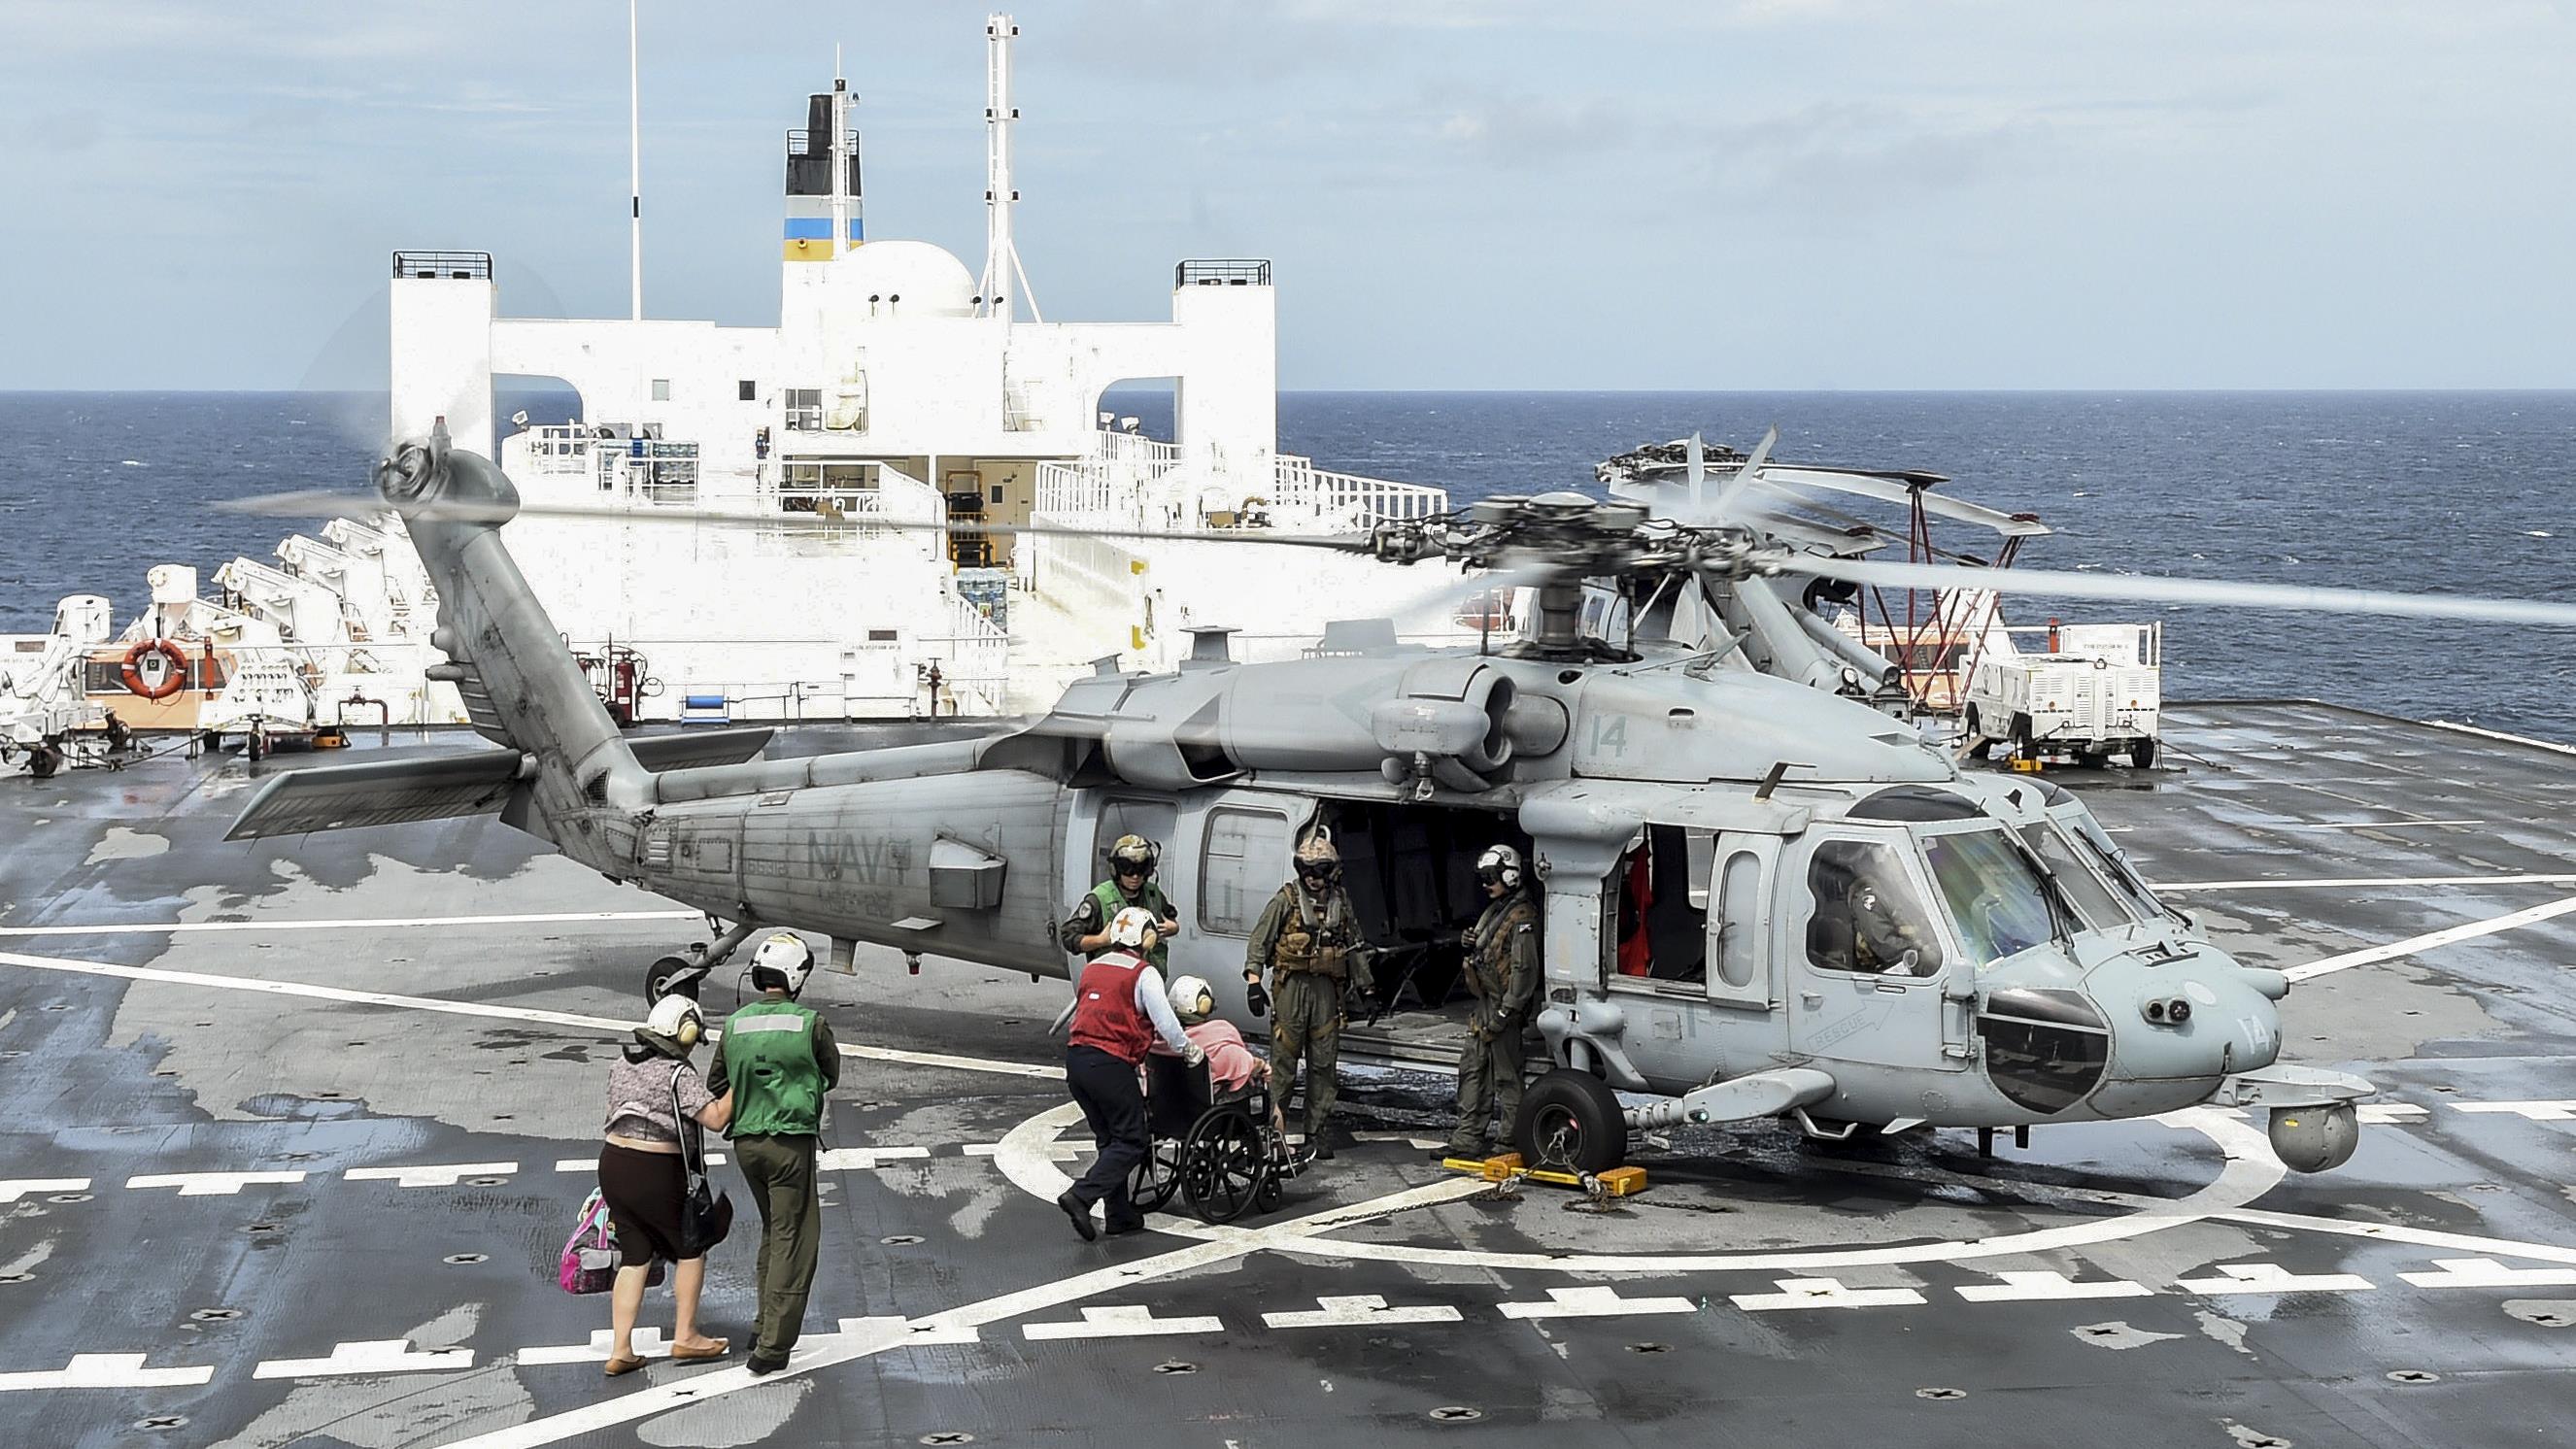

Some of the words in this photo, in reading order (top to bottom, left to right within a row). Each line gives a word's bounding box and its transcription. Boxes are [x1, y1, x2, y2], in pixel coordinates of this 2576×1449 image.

[1590, 714, 1627, 758] 14
[1815, 1014, 1866, 1047] RESCUE
[2236, 1014, 2270, 1055] 14
